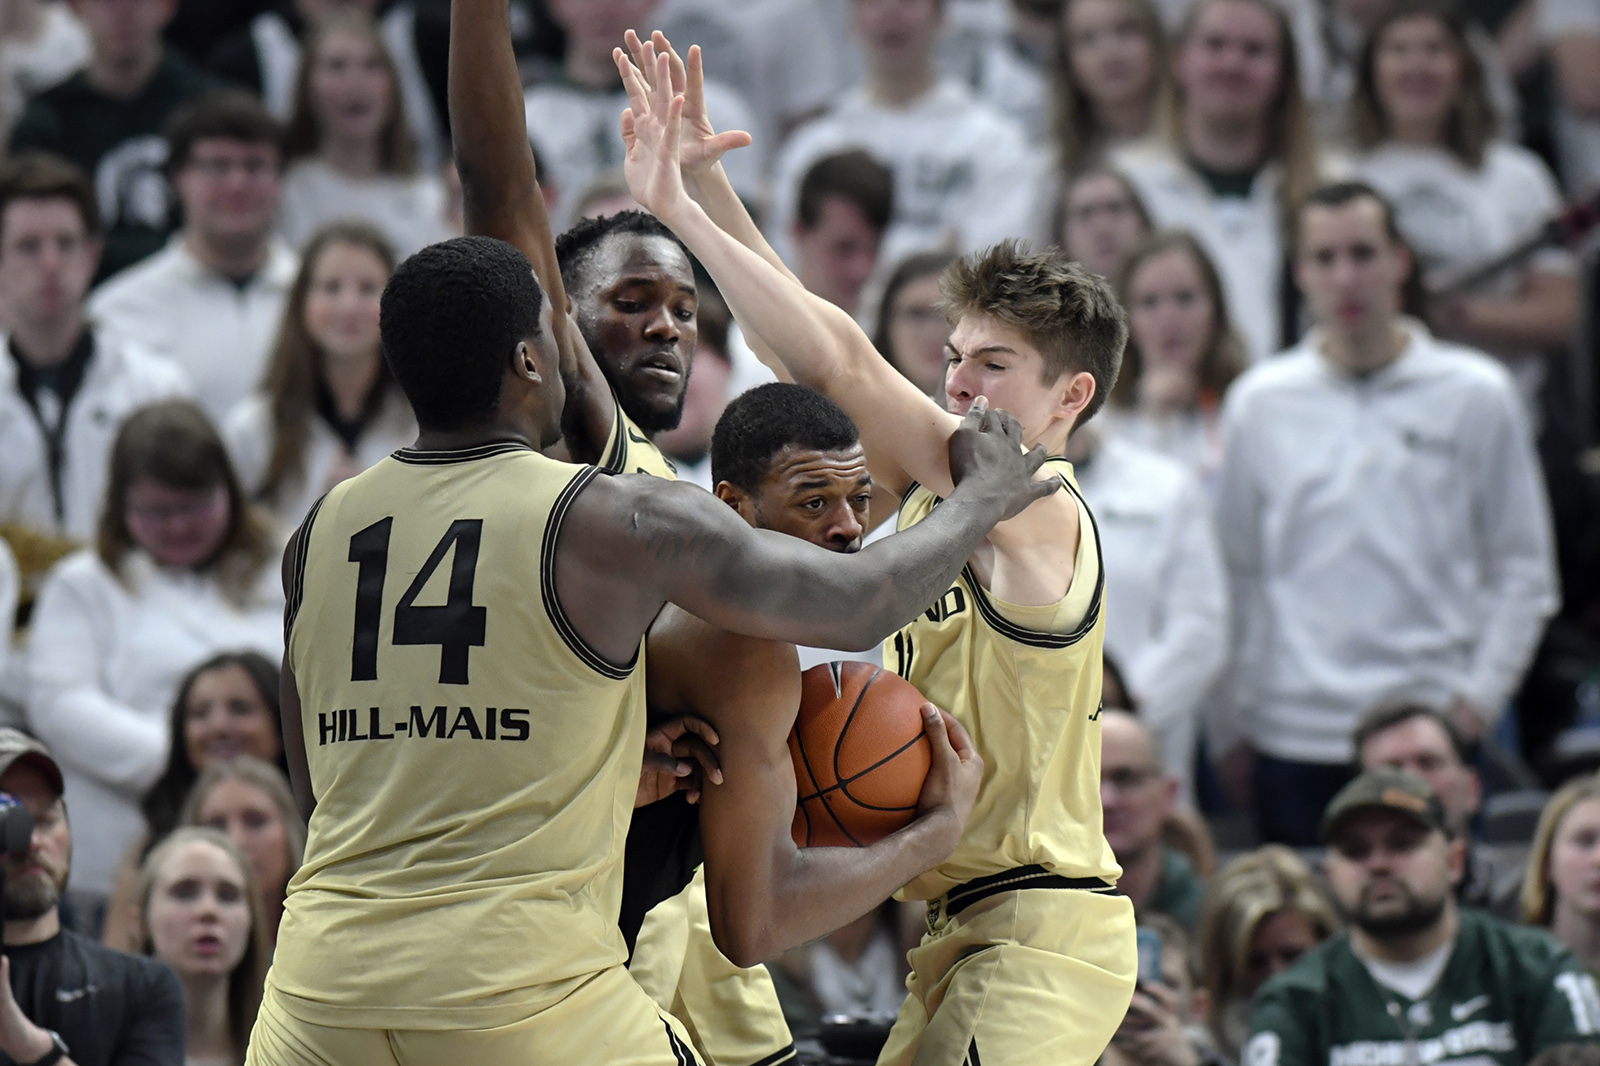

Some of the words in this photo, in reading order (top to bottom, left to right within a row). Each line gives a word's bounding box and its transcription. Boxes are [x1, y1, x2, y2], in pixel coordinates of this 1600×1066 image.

[347, 515, 487, 685] 14
[914, 586, 966, 622] ND
[318, 706, 530, 746] HILL-MAIS
